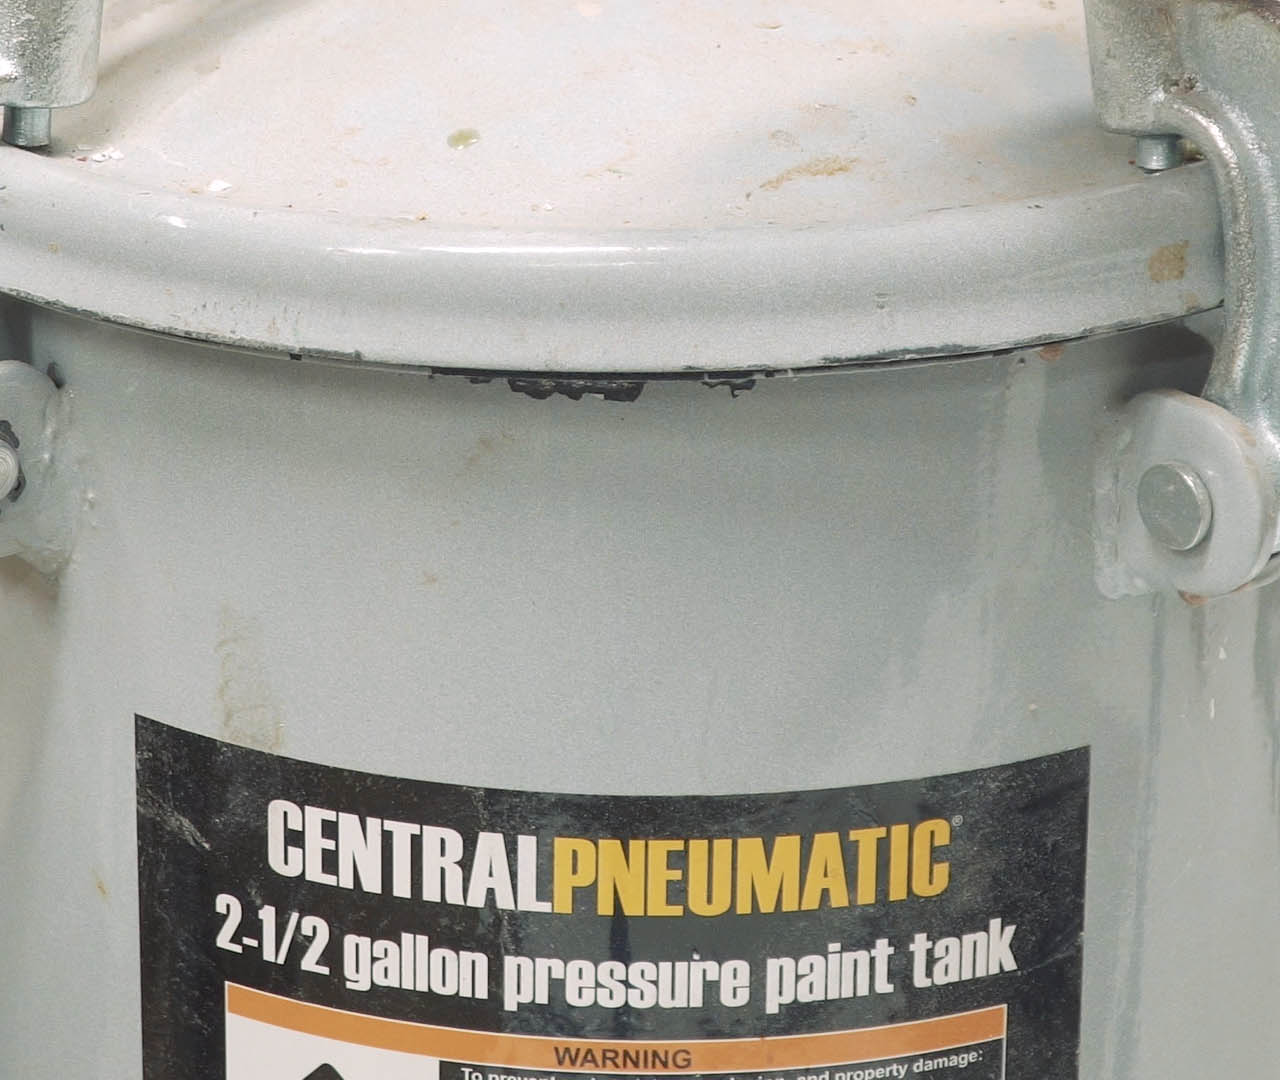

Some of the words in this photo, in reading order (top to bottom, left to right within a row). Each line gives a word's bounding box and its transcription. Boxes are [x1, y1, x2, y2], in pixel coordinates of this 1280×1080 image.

[215, 893, 331, 976] 2-1/2
[343, 932, 489, 1000] gallon
[503, 951, 751, 1012] pressure
[765, 938, 895, 1014] paint
[910, 918, 1018, 989] tank
[553, 1046, 692, 1069] WARNING
[912, 1049, 984, 1073] damage:
